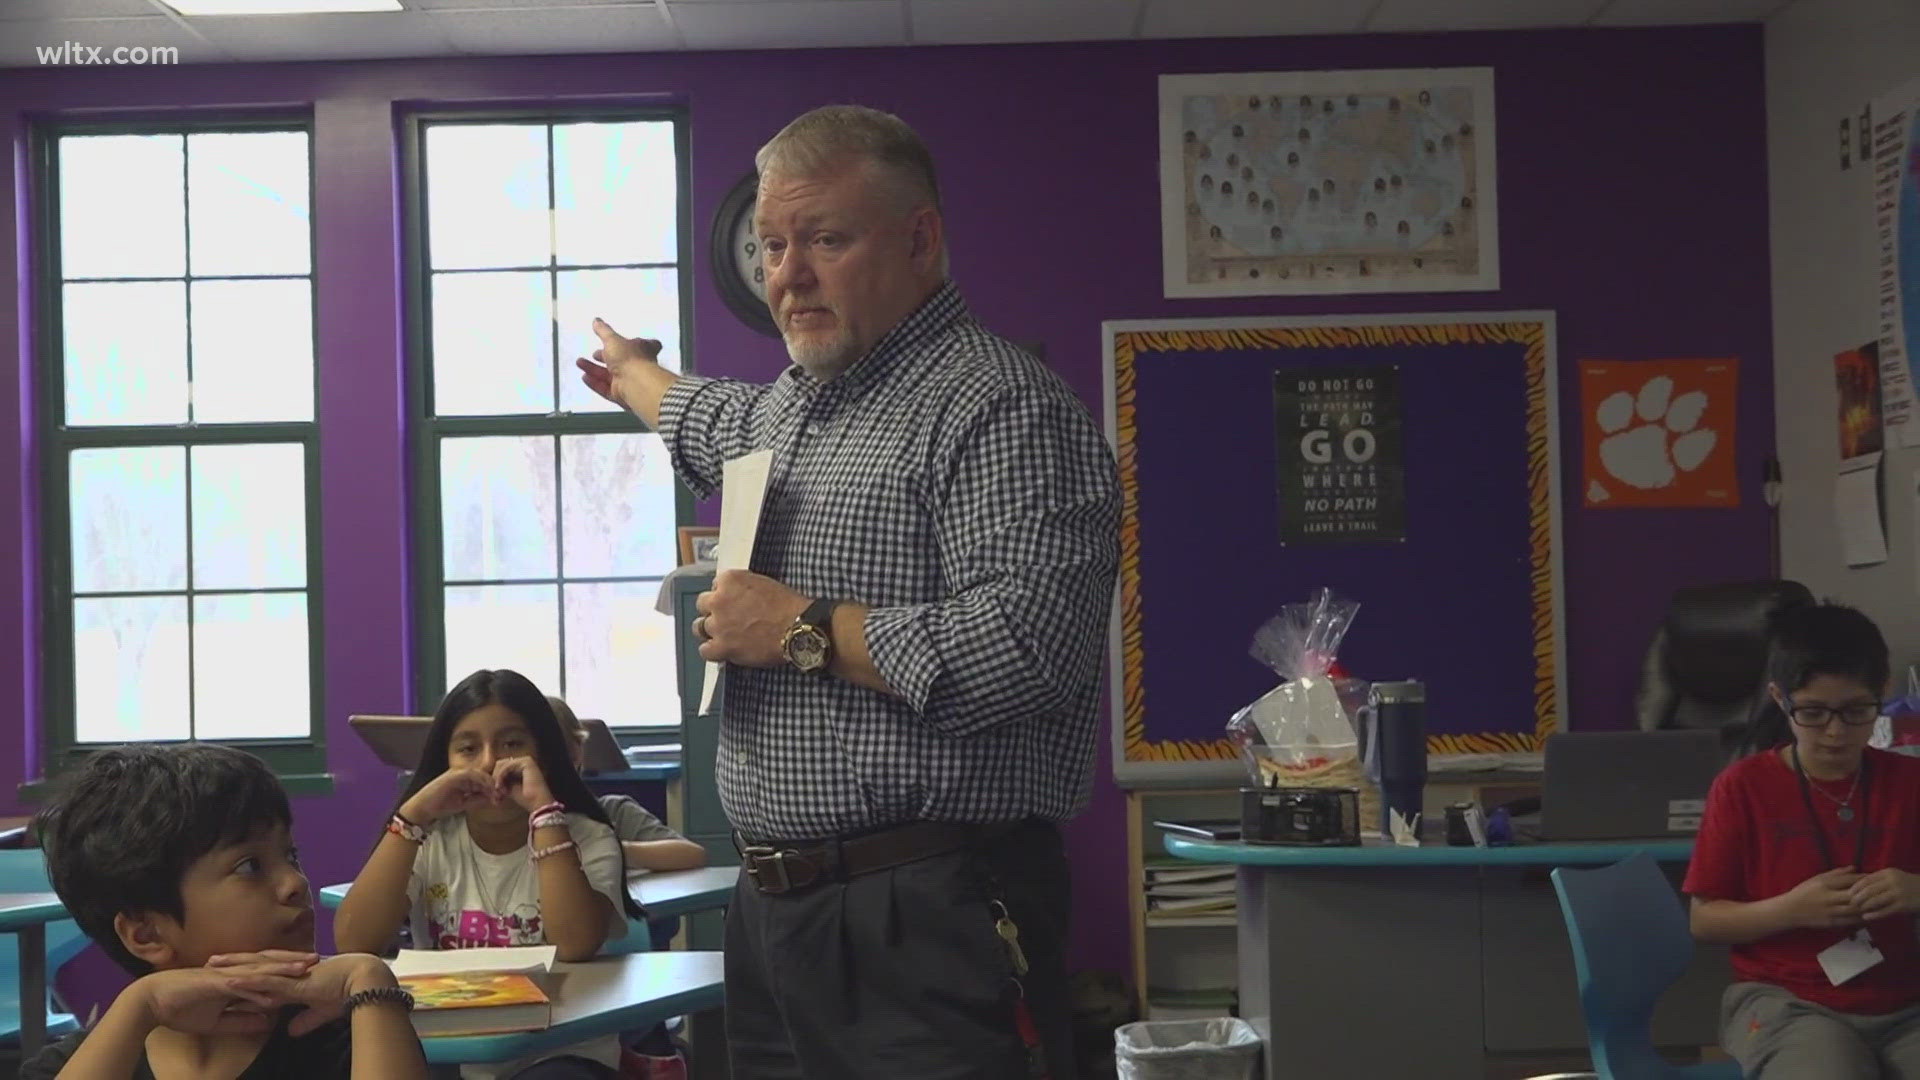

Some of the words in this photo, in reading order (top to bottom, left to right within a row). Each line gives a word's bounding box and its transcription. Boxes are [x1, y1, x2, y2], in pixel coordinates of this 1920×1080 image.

[744, 242, 756, 259] 9
[754, 266, 765, 284] 8
[1298, 379, 1317, 392] DO
[1323, 379, 1349, 392] NOT
[1356, 378, 1374, 391] GO
[1300, 429, 1376, 464] GO
[1303, 473, 1376, 488] WHERE
[1304, 498, 1330, 512] NO
[1334, 496, 1377, 511] PATH
[459, 909, 510, 946] BE
